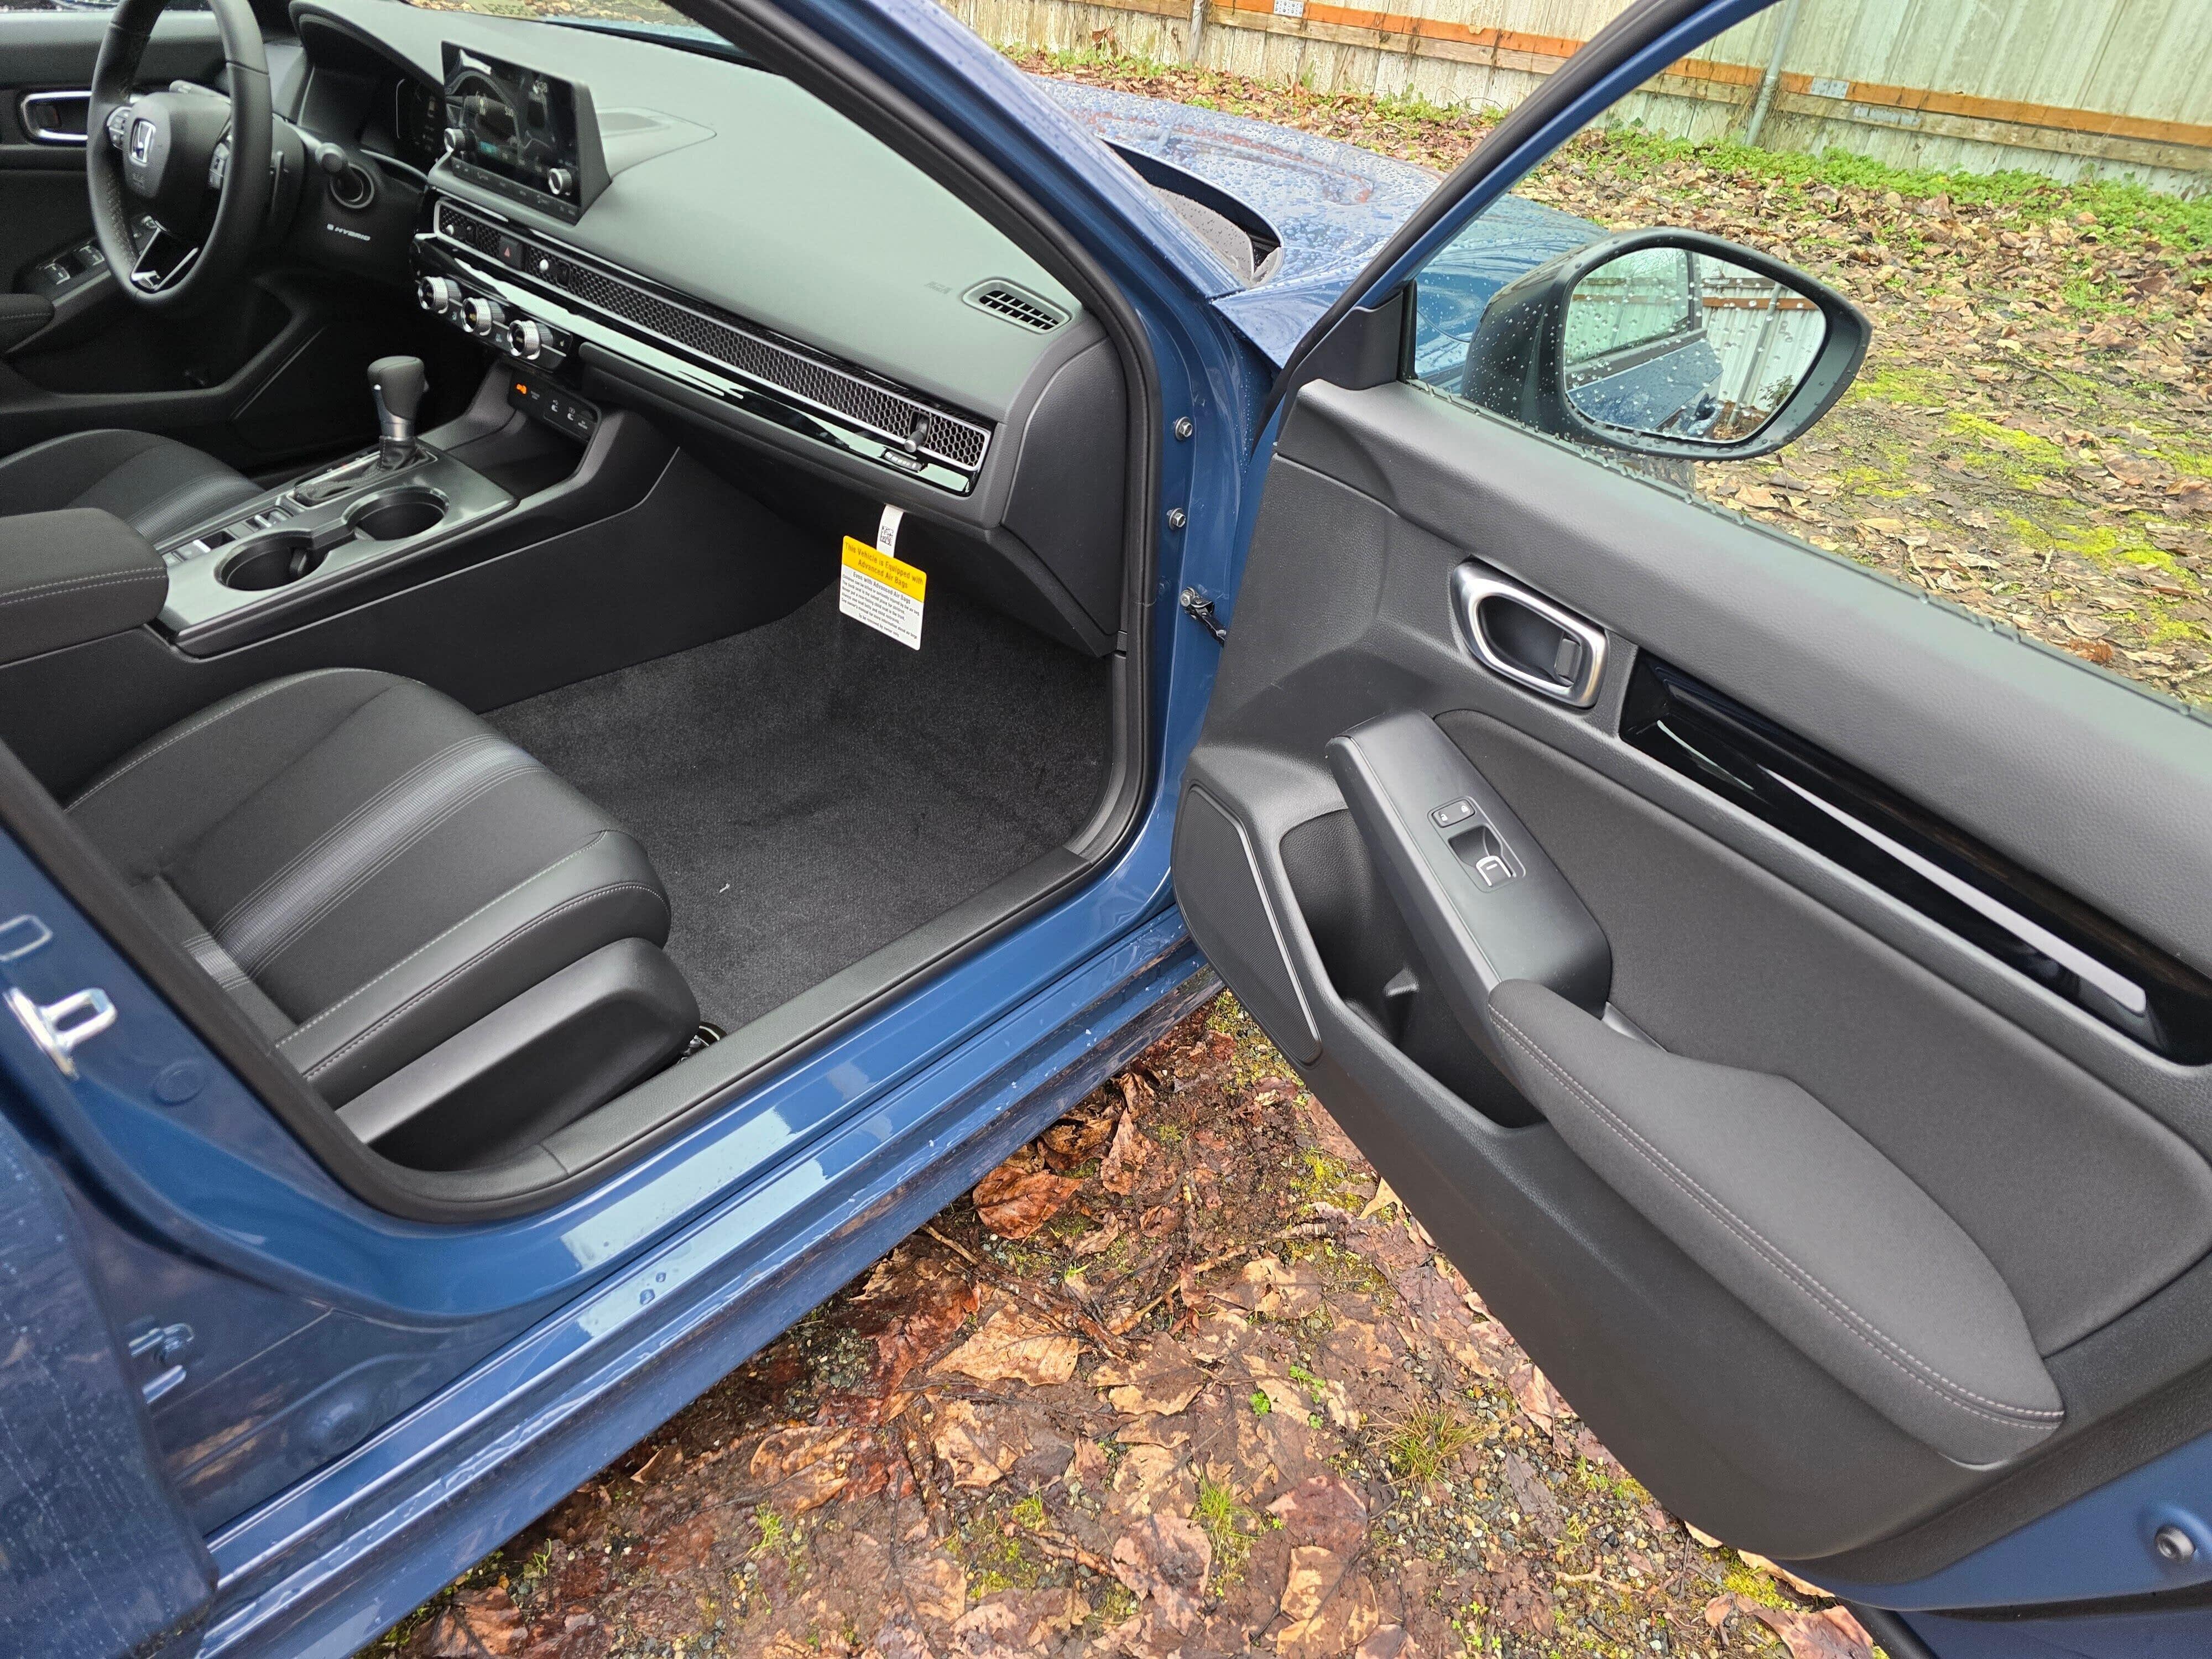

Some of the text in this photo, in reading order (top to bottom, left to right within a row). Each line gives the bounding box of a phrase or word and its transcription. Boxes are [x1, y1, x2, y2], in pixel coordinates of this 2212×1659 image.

[846, 542, 855, 553] This
[858, 547, 877, 563] Vehicle
[885, 561, 910, 579] Equipped
[912, 576, 923, 585] with
[858, 559, 884, 576] Advanced
[895, 577, 907, 588] Bags
[853, 572, 863, 580] Even
[874, 581, 893, 594] Advanced
[900, 594, 910, 604] Bags
